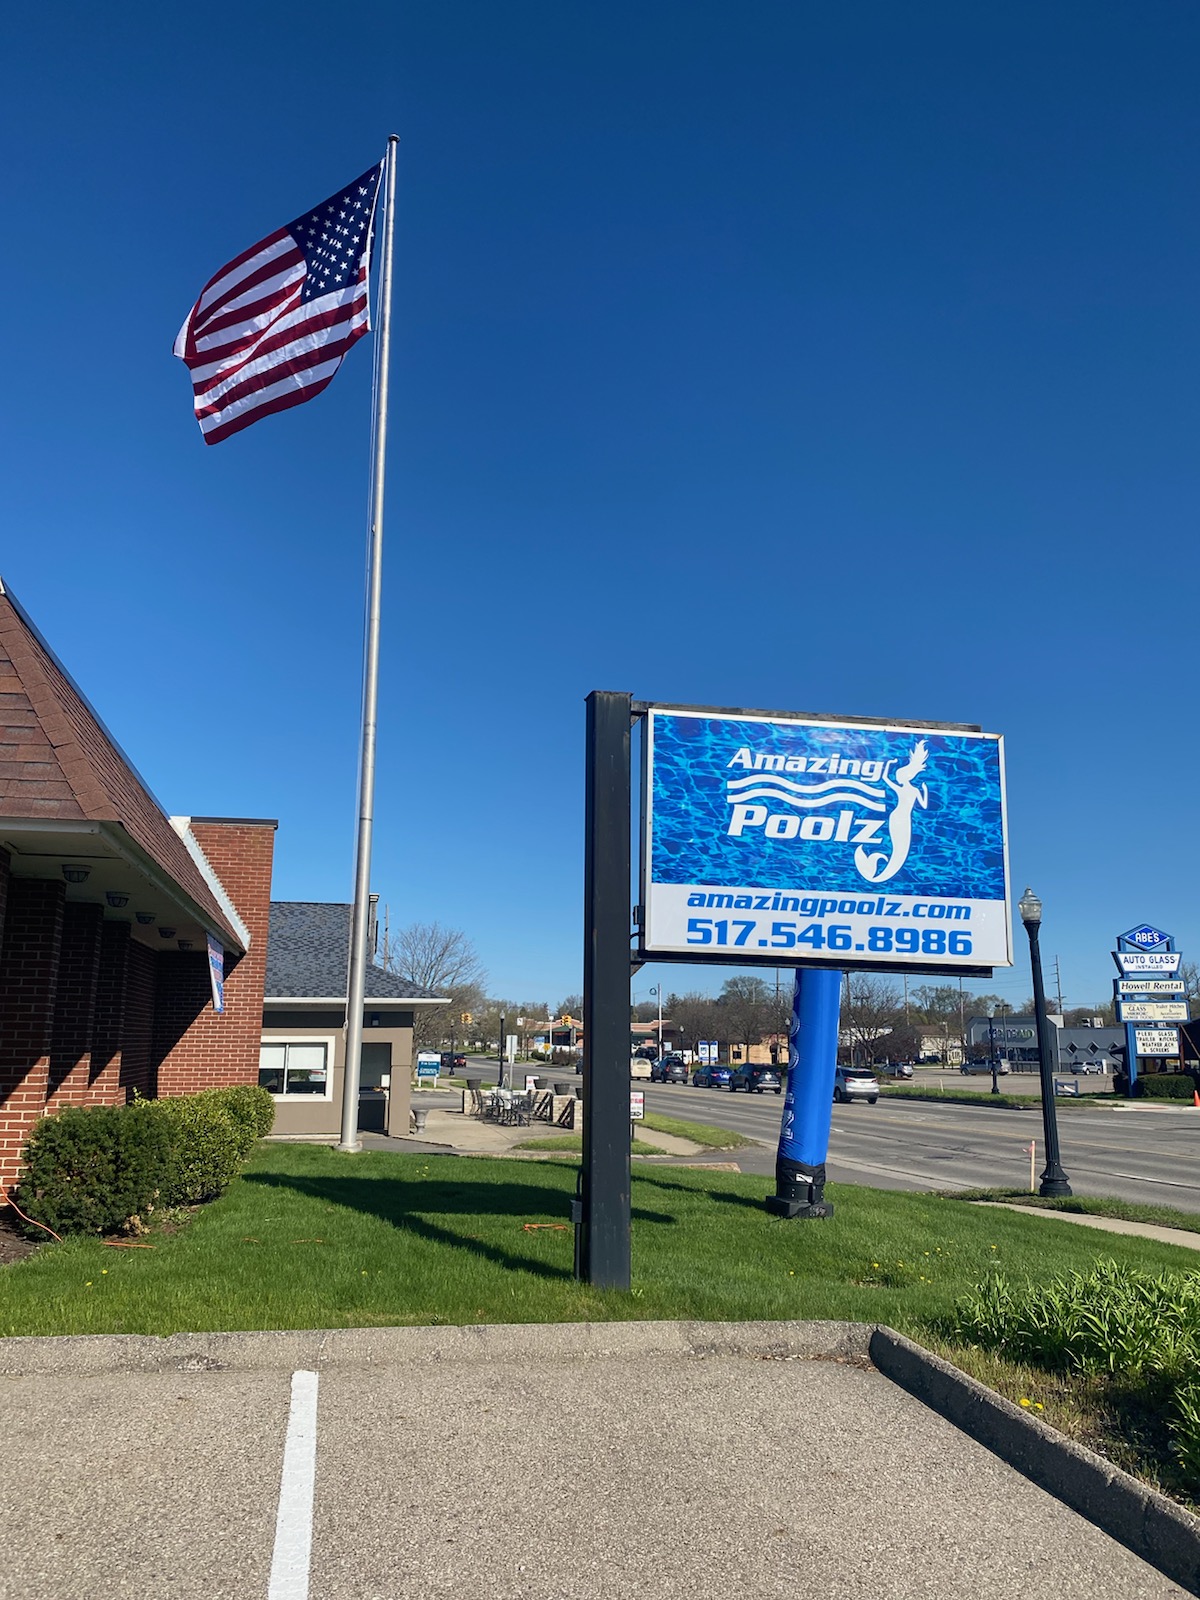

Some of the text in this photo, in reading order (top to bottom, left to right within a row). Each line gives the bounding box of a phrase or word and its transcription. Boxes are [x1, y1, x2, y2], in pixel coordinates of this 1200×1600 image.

[727, 747, 885, 781] Amazing
[727, 804, 886, 844] Poolz
[687, 891, 972, 920] amazingpoolz.com
[687, 918, 973, 956] 517.546.8986
[1135, 931, 1160, 943] ABE'S
[1123, 956, 1176, 964] AUTO GLASS
[1153, 982, 1182, 990] Rental
